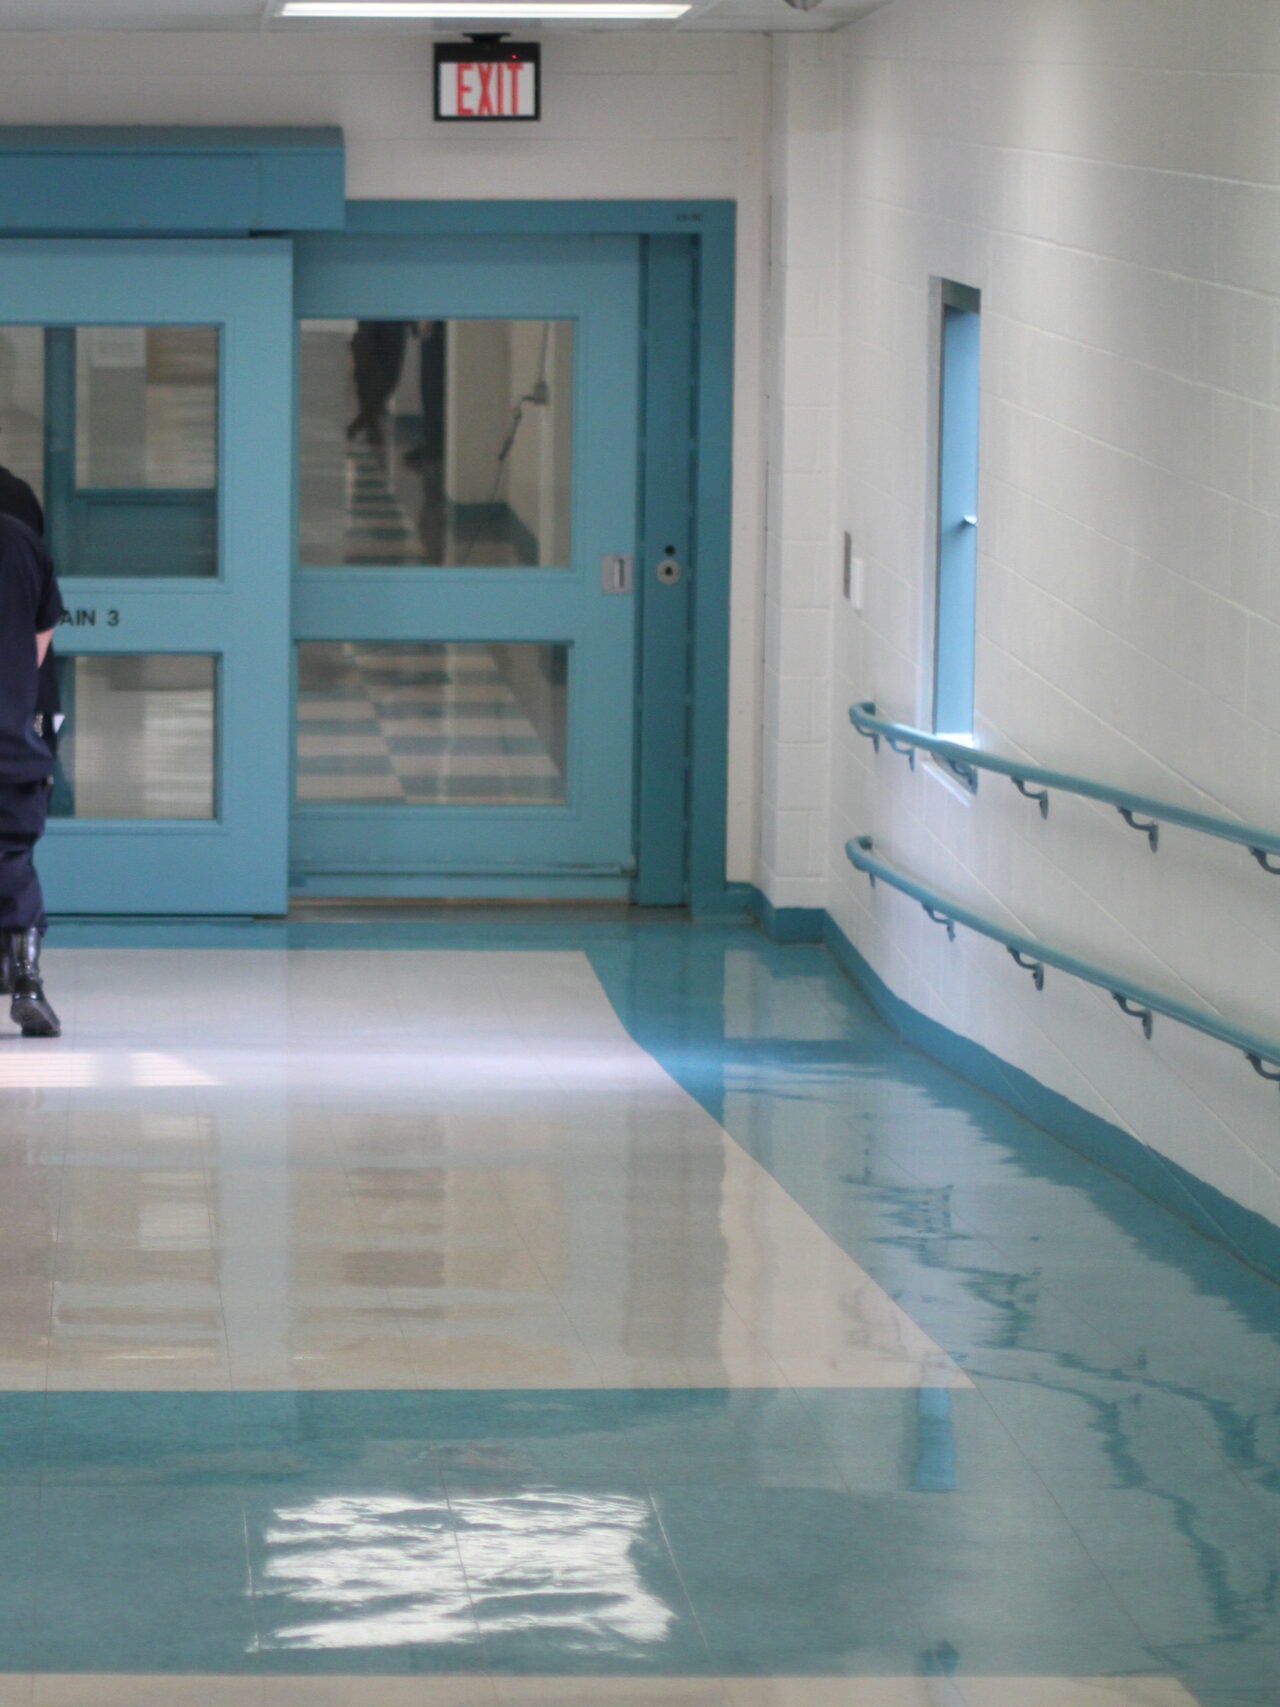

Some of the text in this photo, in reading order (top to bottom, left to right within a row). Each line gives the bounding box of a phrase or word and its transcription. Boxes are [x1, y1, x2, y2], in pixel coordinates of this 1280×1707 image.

[457, 61, 523, 116] EXIT
[59, 609, 120, 627] AIN 3
